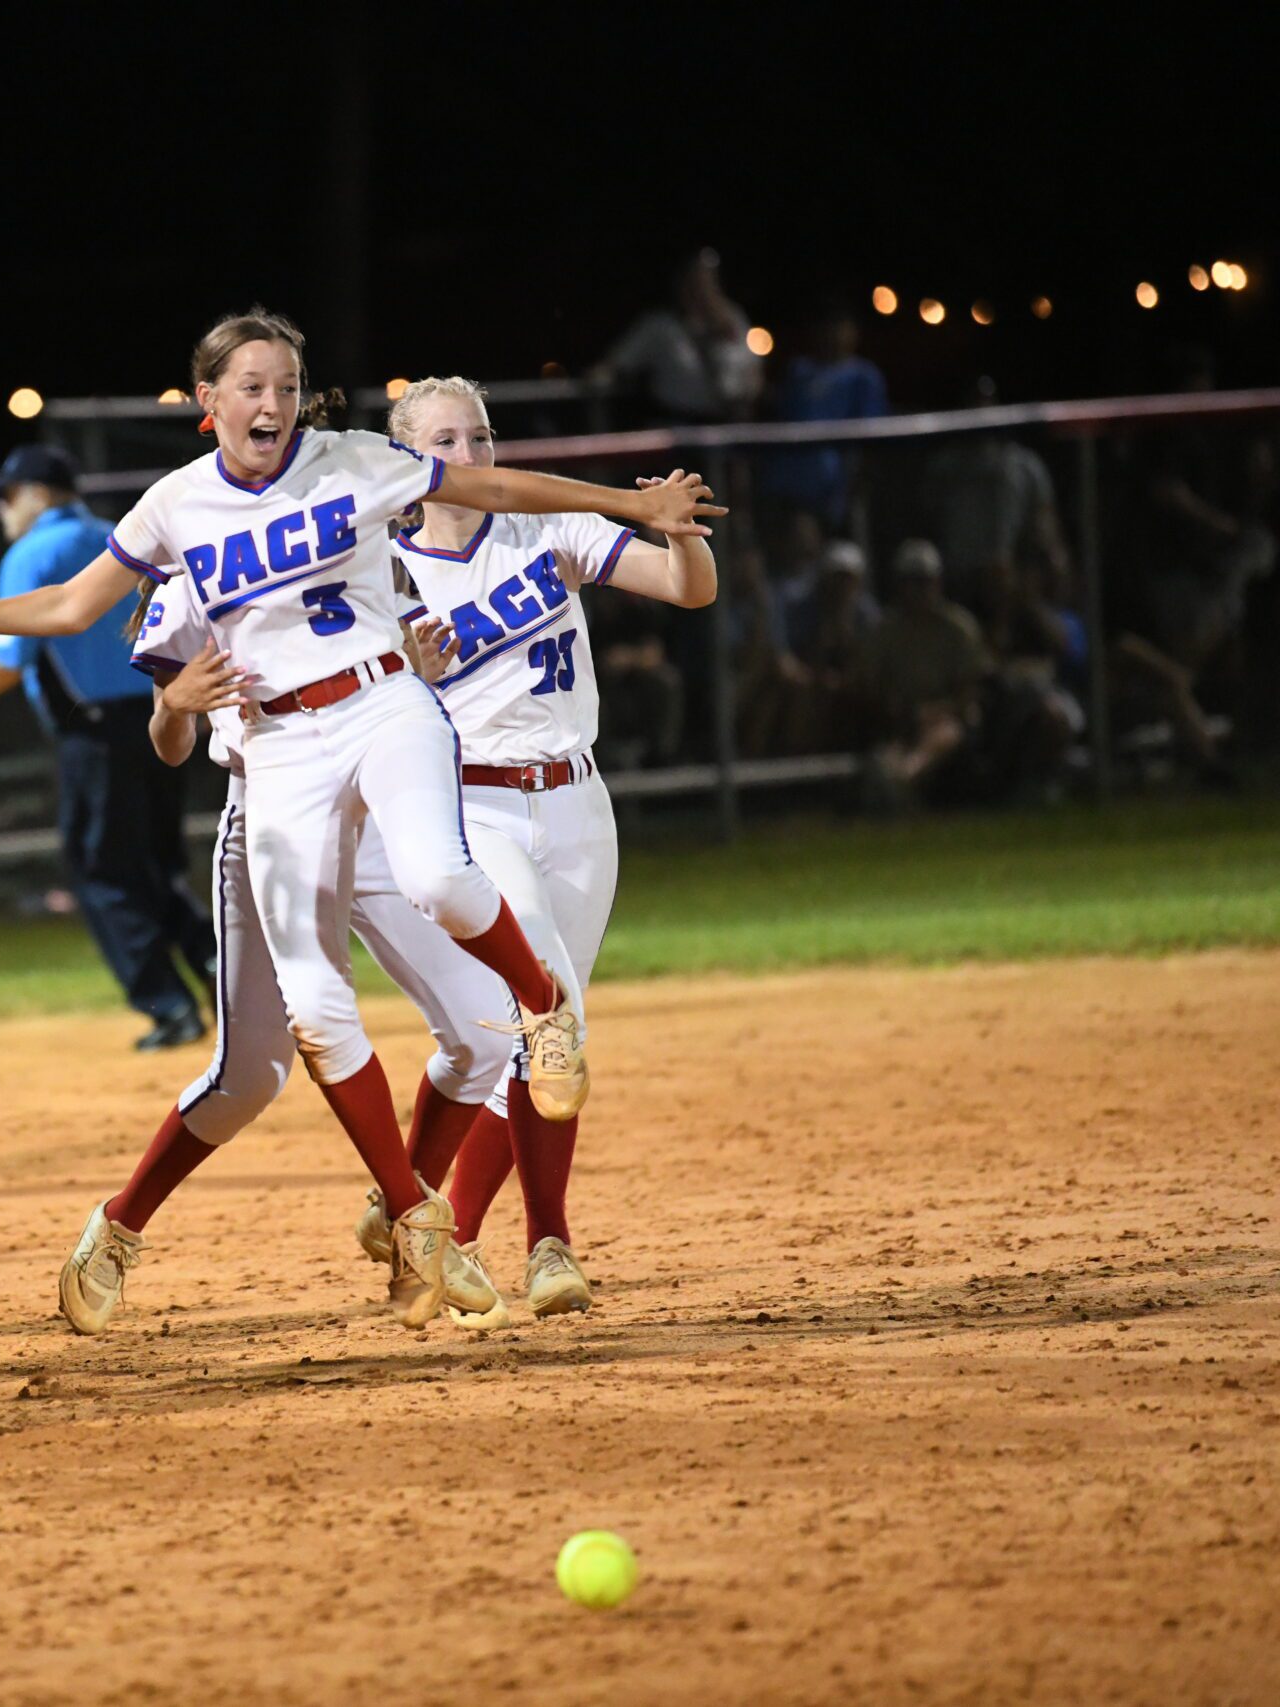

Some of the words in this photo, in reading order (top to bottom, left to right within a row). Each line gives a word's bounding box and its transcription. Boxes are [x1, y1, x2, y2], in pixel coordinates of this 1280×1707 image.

[183, 494, 357, 604] PACE
[302, 580, 356, 636] 3
[438, 548, 569, 664] ACE
